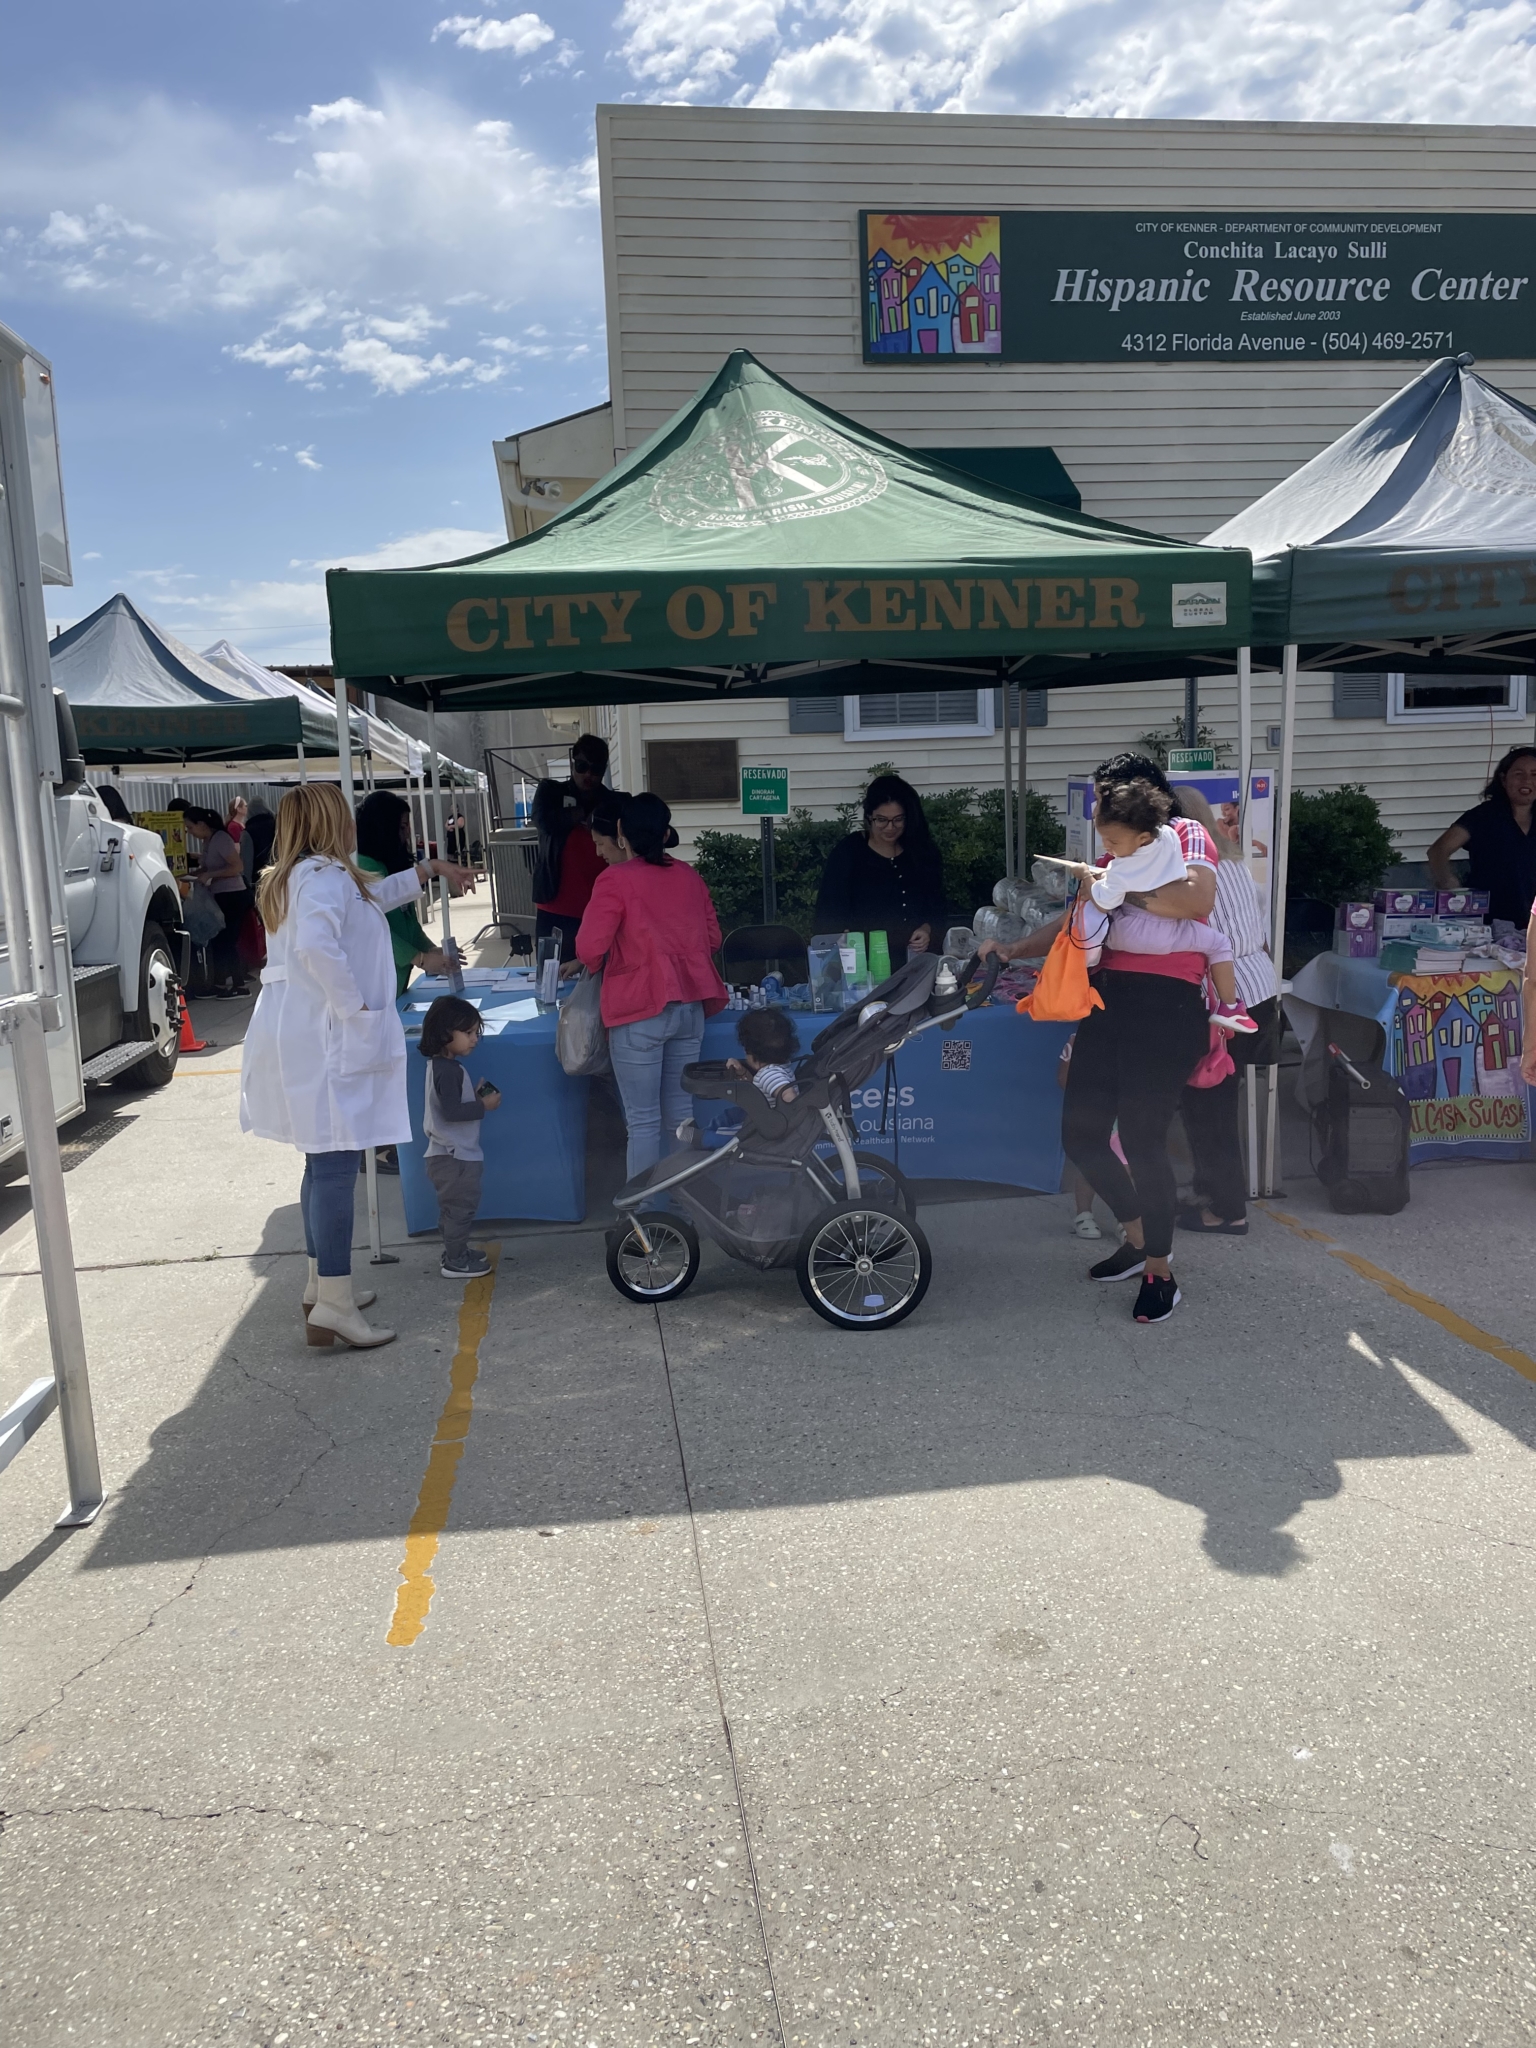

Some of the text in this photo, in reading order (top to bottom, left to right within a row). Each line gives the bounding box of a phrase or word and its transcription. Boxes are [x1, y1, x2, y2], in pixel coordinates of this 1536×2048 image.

[1135, 223, 1158, 232] CITY
[1160, 223, 1174, 232] OF
[1176, 223, 1218, 233] KENNER
[1225, 223, 1292, 233] DEPARTMENT
[1293, 223, 1308, 233] OF
[1309, 223, 1369, 233] COMMUNITY
[1370, 223, 1443, 233] DEVELOPMENT
[1183, 241, 1388, 263] Conchita Lacayo Sulli
[1050, 268, 1529, 311] Hispanic Resource Center
[1240, 311, 1341, 321] Established June 2003
[1121, 333, 1167, 351] 4312
[1172, 333, 1233, 351] Florida
[1237, 333, 1306, 351] Avenue
[1322, 332, 1368, 354] (504)
[1372, 331, 1454, 350] 469-2571
[446, 577, 1146, 652] CITY OF KENNER
[1171, 752, 1213, 763] RESERVADO
[743, 769, 787, 780] RESERVADO
[851, 1086, 915, 1110] cess
[856, 1113, 935, 1133] ouisiana
[853, 1135, 936, 1146] ealthcar Network
